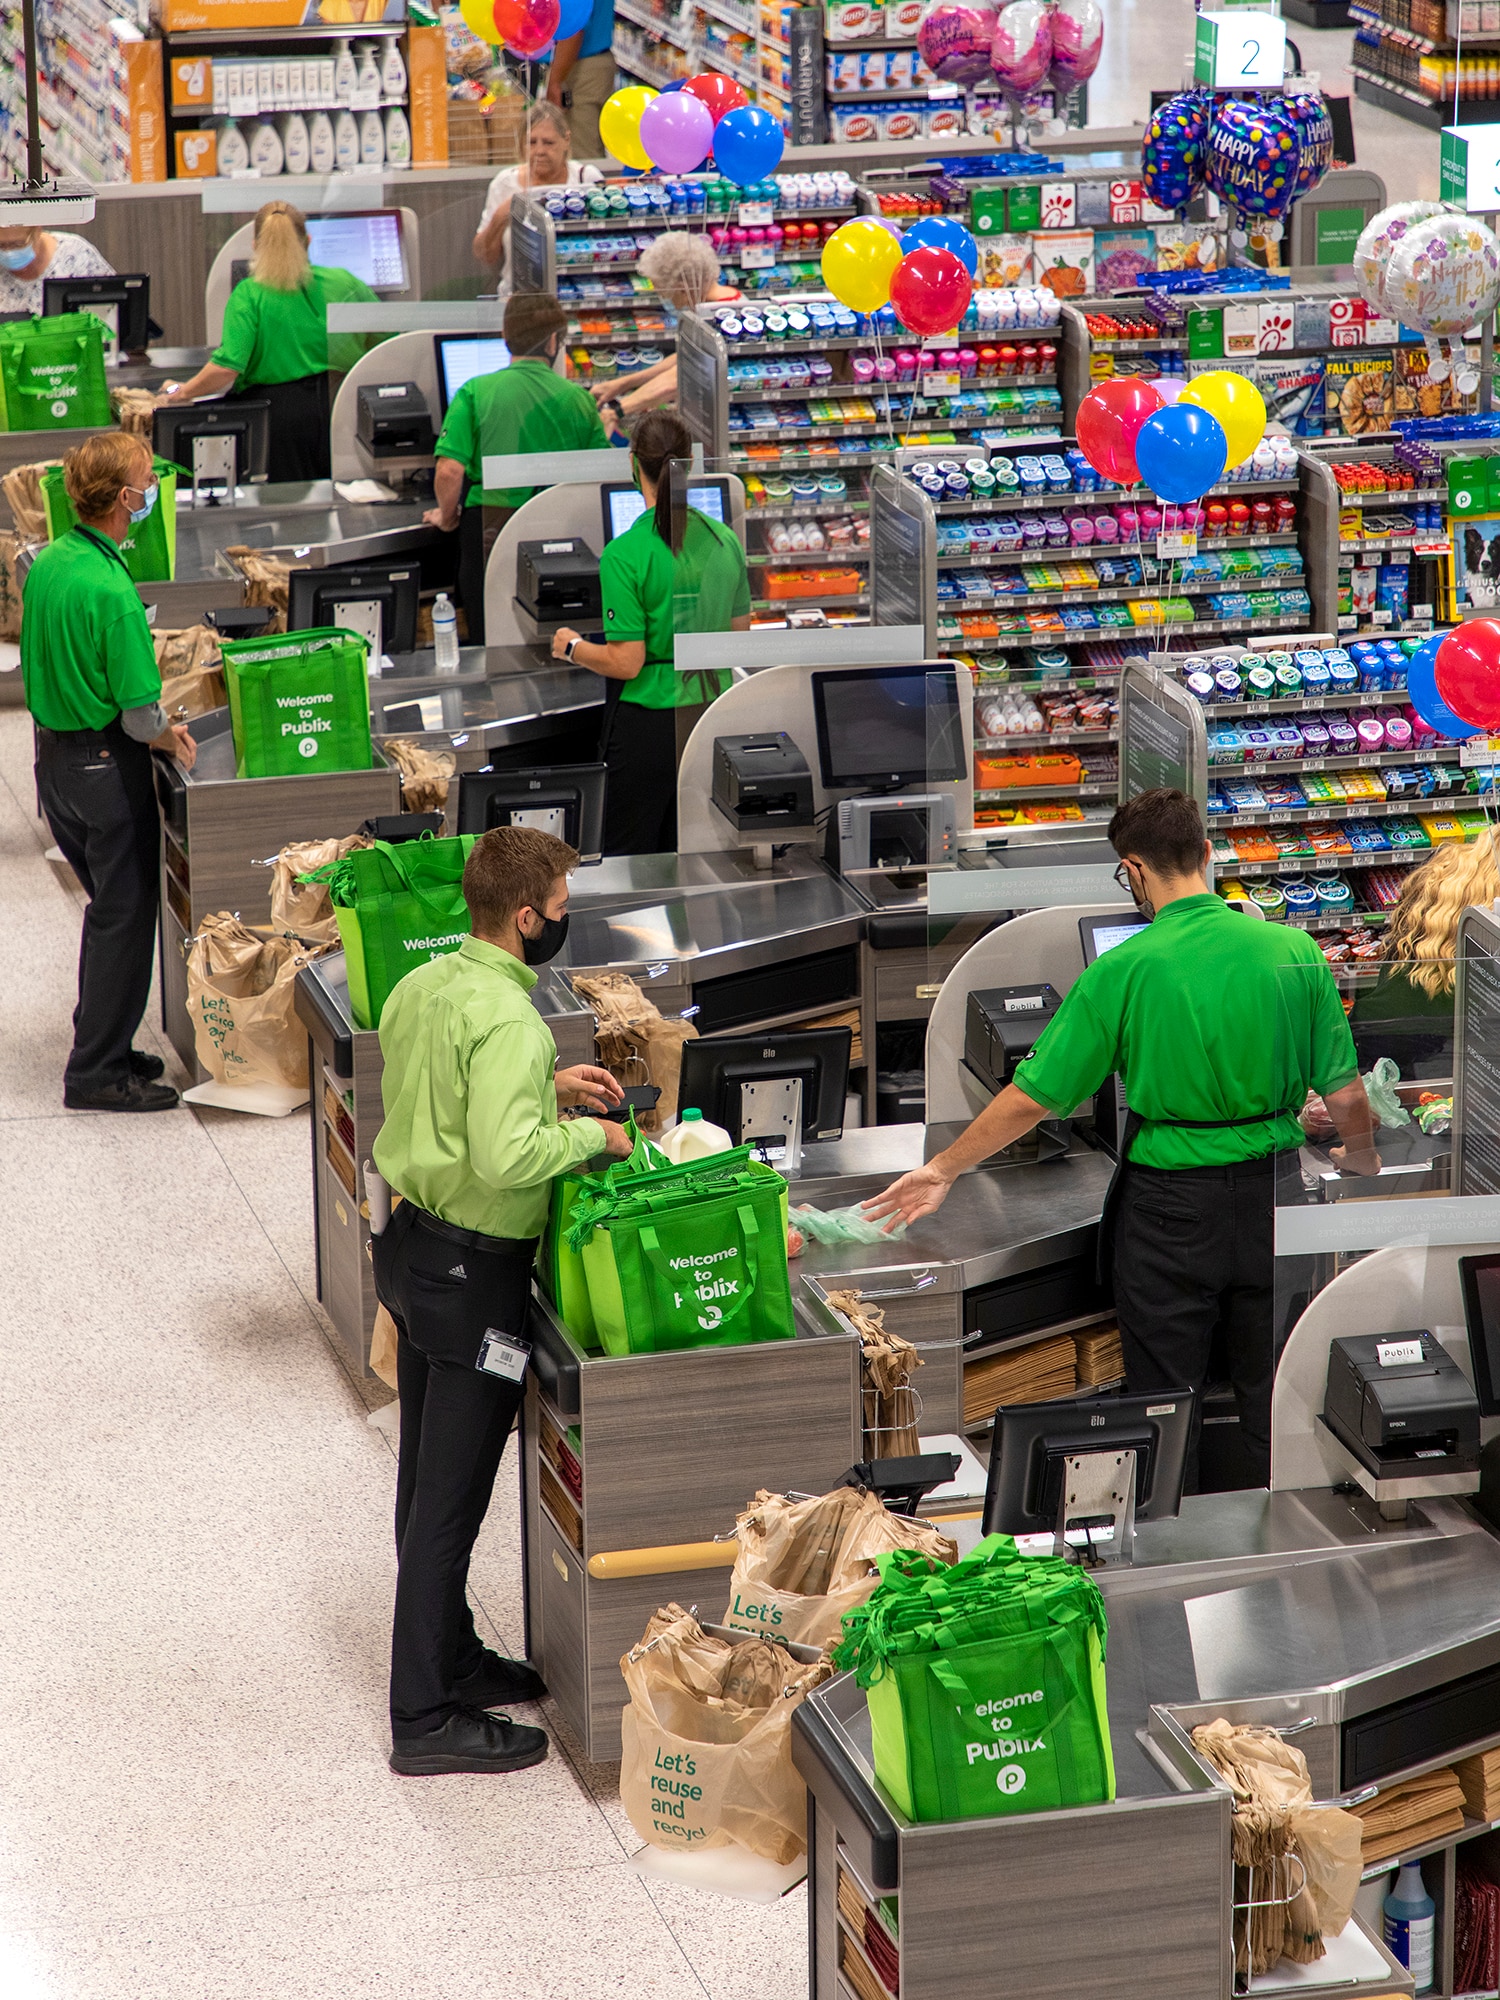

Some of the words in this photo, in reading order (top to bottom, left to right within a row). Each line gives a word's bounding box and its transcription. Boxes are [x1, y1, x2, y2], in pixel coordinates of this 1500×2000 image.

[1240, 39, 1260, 75] 2
[1213, 129, 1260, 166] HAPPY
[30, 364, 78, 377] Welcome
[1326, 362, 1352, 375] FALL
[1352, 359, 1393, 374] RECIPES
[49, 376, 62, 386] to
[1261, 369, 1302, 382] ULTIMATE
[1277, 373, 1321, 390] SHARKS
[1422, 468, 1442, 476] EXTRA
[1457, 577, 1494, 588] GENIUS
[276, 692, 334, 709] Welcome
[298, 707, 313, 719] to
[281, 718, 332, 737] Publix
[403, 931, 467, 951] Welcome
[1010, 1003, 1037, 1011] Publix
[669, 1247, 738, 1270] Welcome
[693, 1270, 713, 1282] to
[1384, 1347, 1416, 1358] Publix
[1389, 1420, 1406, 1428] EPSON
[732, 1594, 784, 1626] Let's
[990, 1716, 1013, 1732] to
[965, 1735, 1047, 1765] Publix
[654, 1746, 697, 1776] Let's
[650, 1773, 703, 1801] reuse
[650, 1797, 685, 1819] and
